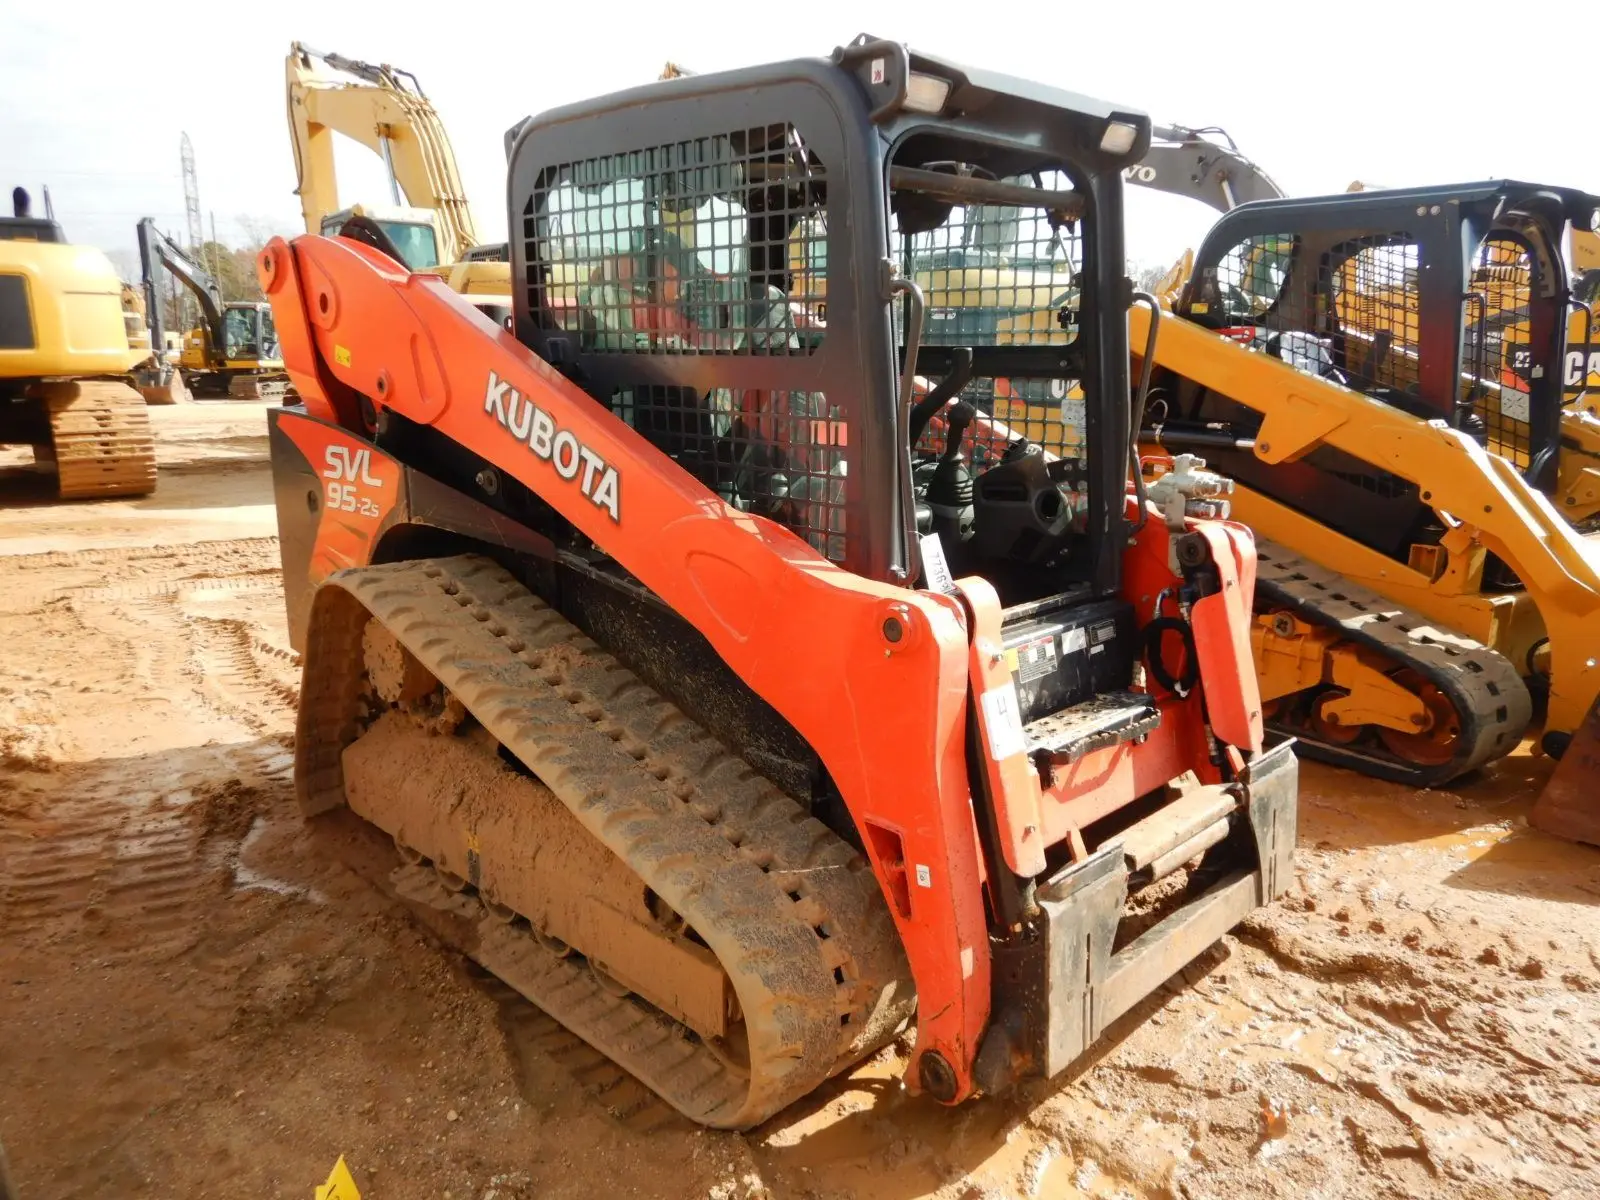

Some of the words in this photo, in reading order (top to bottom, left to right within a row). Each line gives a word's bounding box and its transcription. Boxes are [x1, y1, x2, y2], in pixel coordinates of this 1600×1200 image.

[1563, 351, 1600, 386] CA
[323, 445, 383, 487] SVL
[484, 370, 621, 521] KUBOTA
